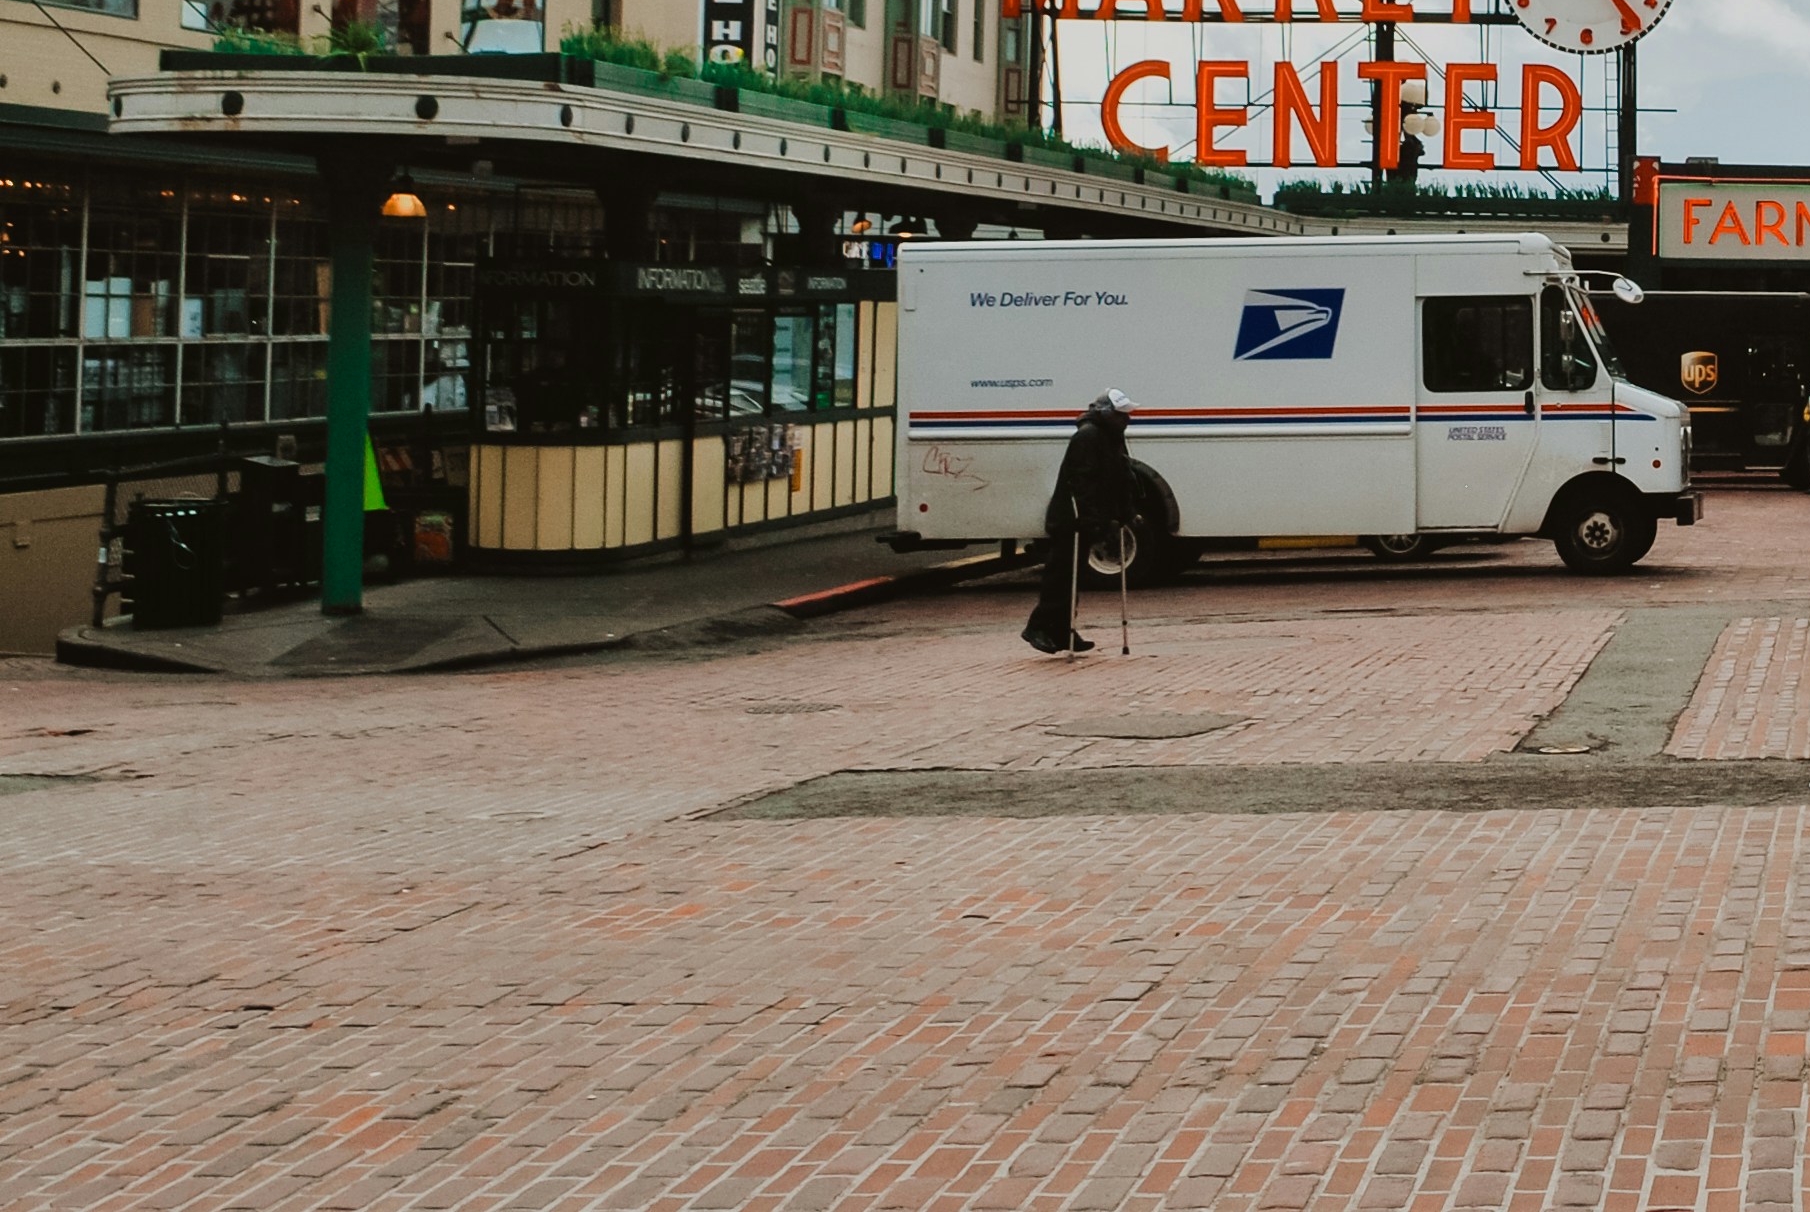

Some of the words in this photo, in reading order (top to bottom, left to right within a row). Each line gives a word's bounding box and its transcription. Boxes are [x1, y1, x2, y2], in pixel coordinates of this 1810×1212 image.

[1544, 17, 1557, 35] 7
[1580, 28, 1593, 45] 6
[1101, 59, 1582, 171] CENTER
[637, 268, 711, 290] INFORMATION
[970, 292, 996, 307] We
[1000, 291, 1060, 307] Deliver
[1063, 291, 1092, 306] For
[1095, 291, 1129, 305] You.
[970, 378, 1054, 390] www.usps.com
[1684, 364, 1716, 388] ups
[1448, 426, 1478, 434] UNITED
[1478, 426, 1505, 434] STATES
[1476, 433, 1507, 441] SERVICE
